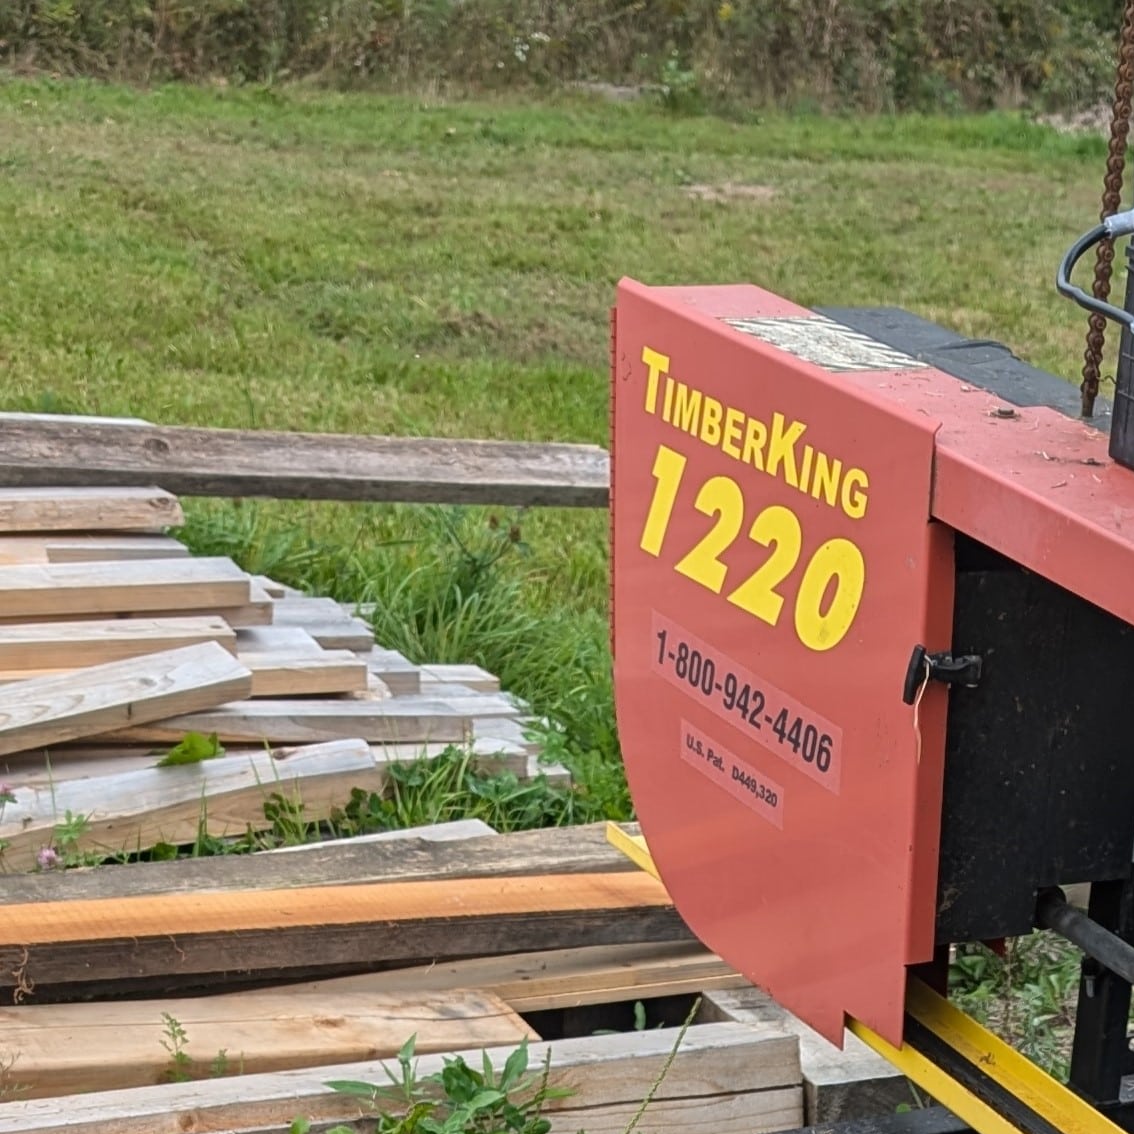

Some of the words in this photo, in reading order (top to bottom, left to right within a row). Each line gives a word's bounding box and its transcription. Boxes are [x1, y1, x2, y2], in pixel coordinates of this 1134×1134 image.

[640, 446, 865, 651] 1220
[657, 630, 833, 773] 1-800-942-4406
[686, 734, 705, 758] U.S.
[706, 748, 725, 772] Pat.
[731, 765, 778, 808] D449,320
